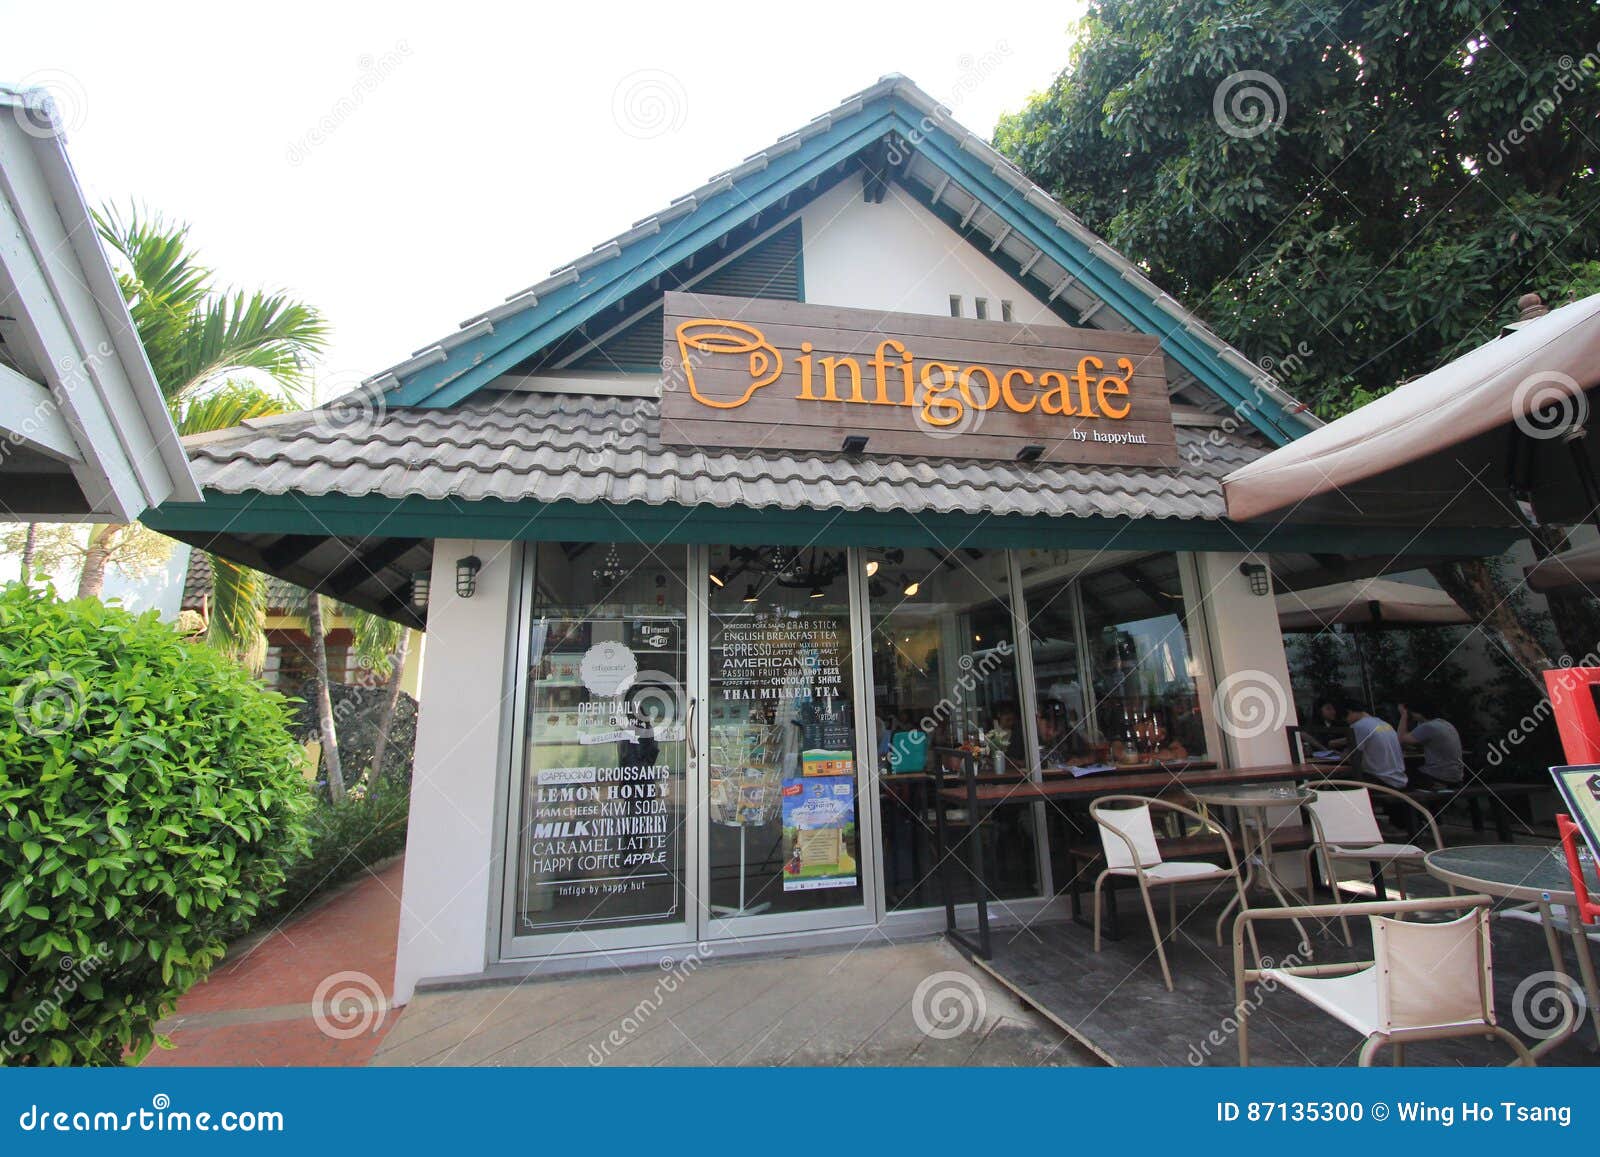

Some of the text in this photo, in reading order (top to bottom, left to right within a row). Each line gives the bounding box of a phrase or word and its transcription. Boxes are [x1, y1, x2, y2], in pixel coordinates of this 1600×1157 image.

[1072, 428, 1147, 444] by happyhut
[786, 620, 837, 630] CRAB STICK
[724, 631, 837, 641] ENGLISH BREAKFAST TEA
[722, 643, 772, 657] ESPRESSO
[722, 656, 840, 668] AMERICANO roti
[722, 668, 755, 678] PASSION
[758, 668, 780, 677] FRUIT
[783, 668, 803, 676] SODA
[771, 675, 841, 686] CHOCOLATE SHAKE
[723, 686, 840, 700] THAI MILKED TEA
[578, 701, 641, 715] OPEN DAILY
[541, 769, 593, 782] CAPPUCINO
[597, 765, 670, 782] CROISSANTS
[537, 783, 669, 803] LEMON HONEY
[536, 806, 598, 818] HAM CHEESE
[601, 800, 667, 817] KIWI SODA
[533, 820, 590, 839] MILK
[591, 815, 669, 837] STRAWBERRY
[532, 835, 667, 856] CARAMEL LATTE
[533, 853, 621, 873] HAPPY COFFEE
[623, 851, 667, 865] APPLE
[589, 884, 599, 895] by
[602, 883, 628, 894] happy
[630, 880, 645, 891] hut
